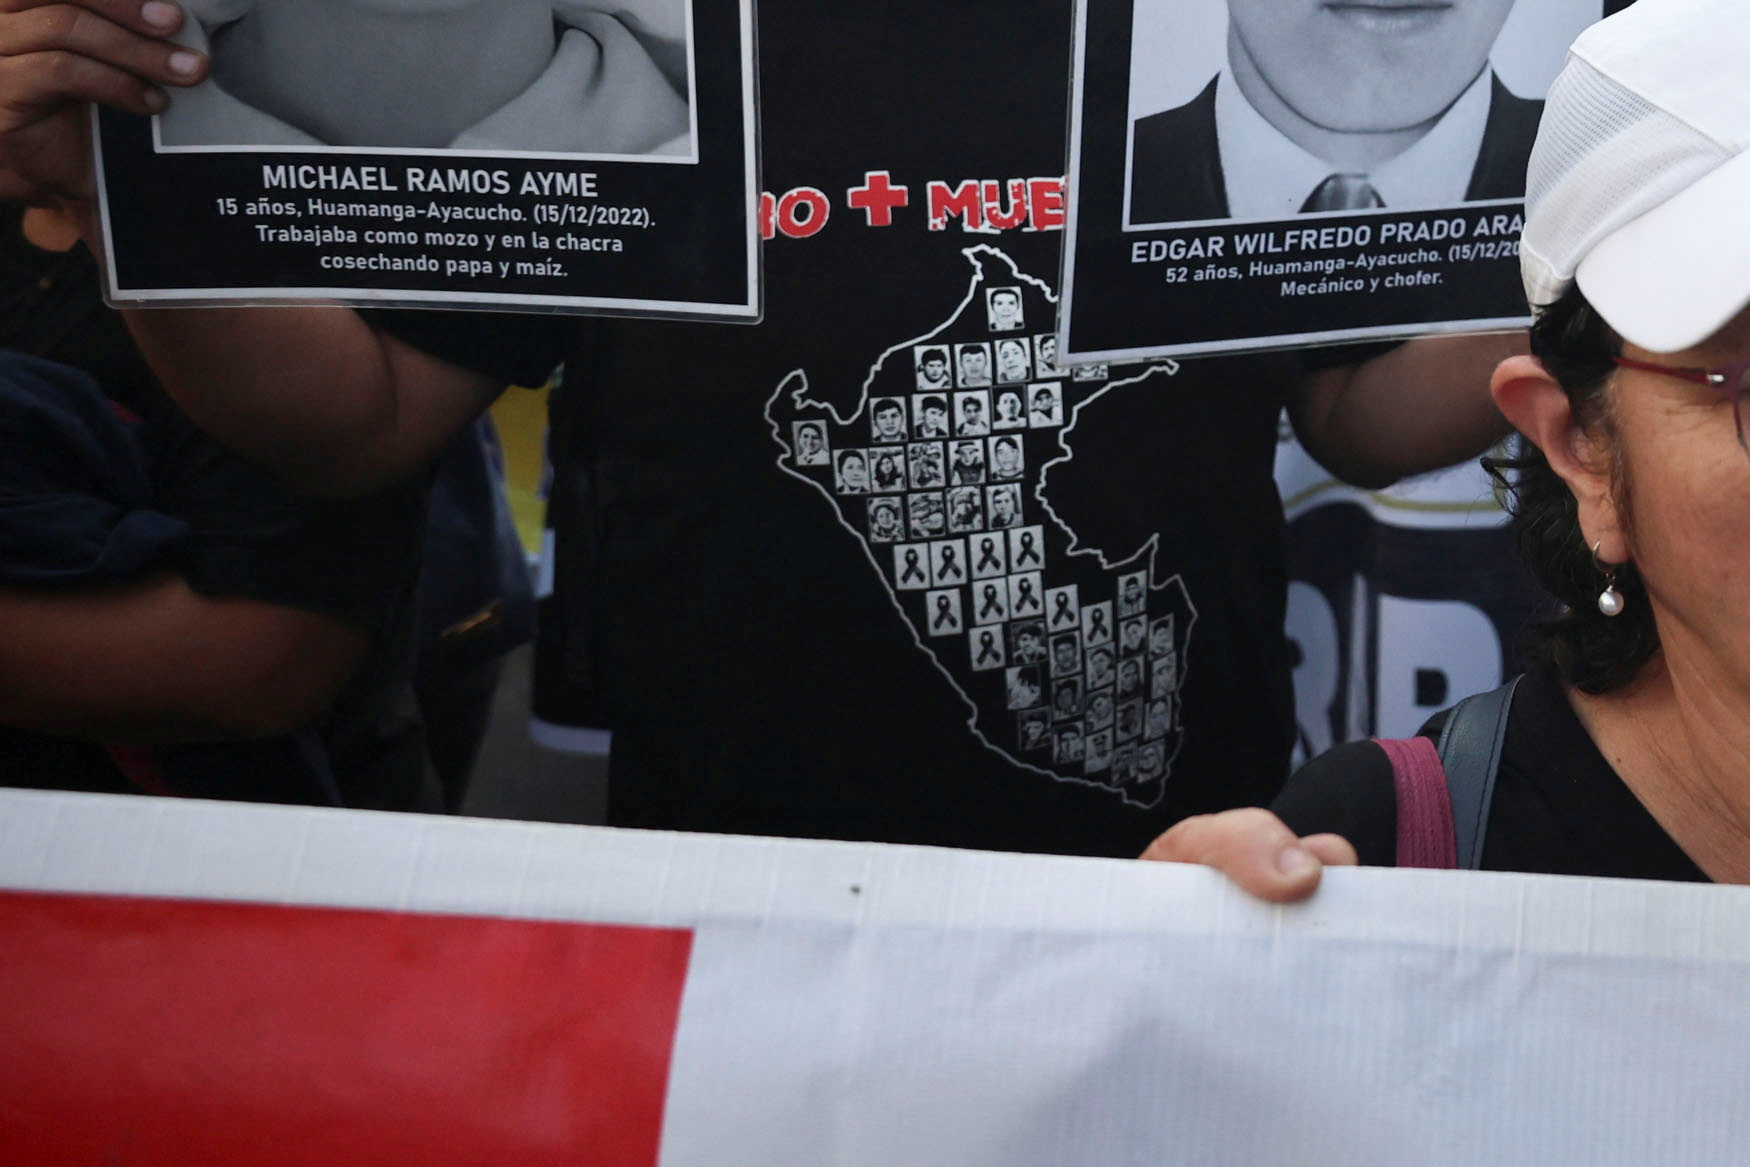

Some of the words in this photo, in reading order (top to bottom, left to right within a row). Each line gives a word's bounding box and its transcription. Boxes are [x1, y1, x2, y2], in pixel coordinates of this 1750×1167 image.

[262, 163, 398, 192] MICHAEL
[406, 167, 511, 195] RAMOS
[520, 170, 598, 198] AYME
[216, 197, 238, 216] 15
[245, 197, 302, 219] años,
[307, 198, 528, 225] Huamanga-Ayacucho.
[533, 203, 656, 228] (15/12/2022).
[927, 177, 1067, 233] MUE
[256, 224, 358, 249] Trabajaba
[364, 230, 418, 246] como
[424, 232, 477, 248] mozo
[483, 235, 495, 252] y
[500, 235, 525, 250] en
[531, 231, 549, 250] la
[555, 232, 623, 252] chacra
[1131, 235, 1225, 264] EDGAR
[1234, 225, 1372, 256] WILFREDO
[1380, 219, 1466, 244] PRADO
[1473, 214, 1523, 237] ARA
[320, 252, 439, 273] cosechando
[446, 256, 493, 277] papa
[499, 259, 510, 278] y
[515, 256, 568, 278] maíz.
[1165, 267, 1188, 283] 52
[1193, 263, 1244, 282] años,
[1249, 248, 1443, 278] Huamanga-Ayacucho.
[1448, 240, 1520, 262] (15/12/20
[1280, 275, 1364, 297] Mecánico
[1369, 278, 1379, 294] y
[1384, 270, 1443, 288] chofer.
